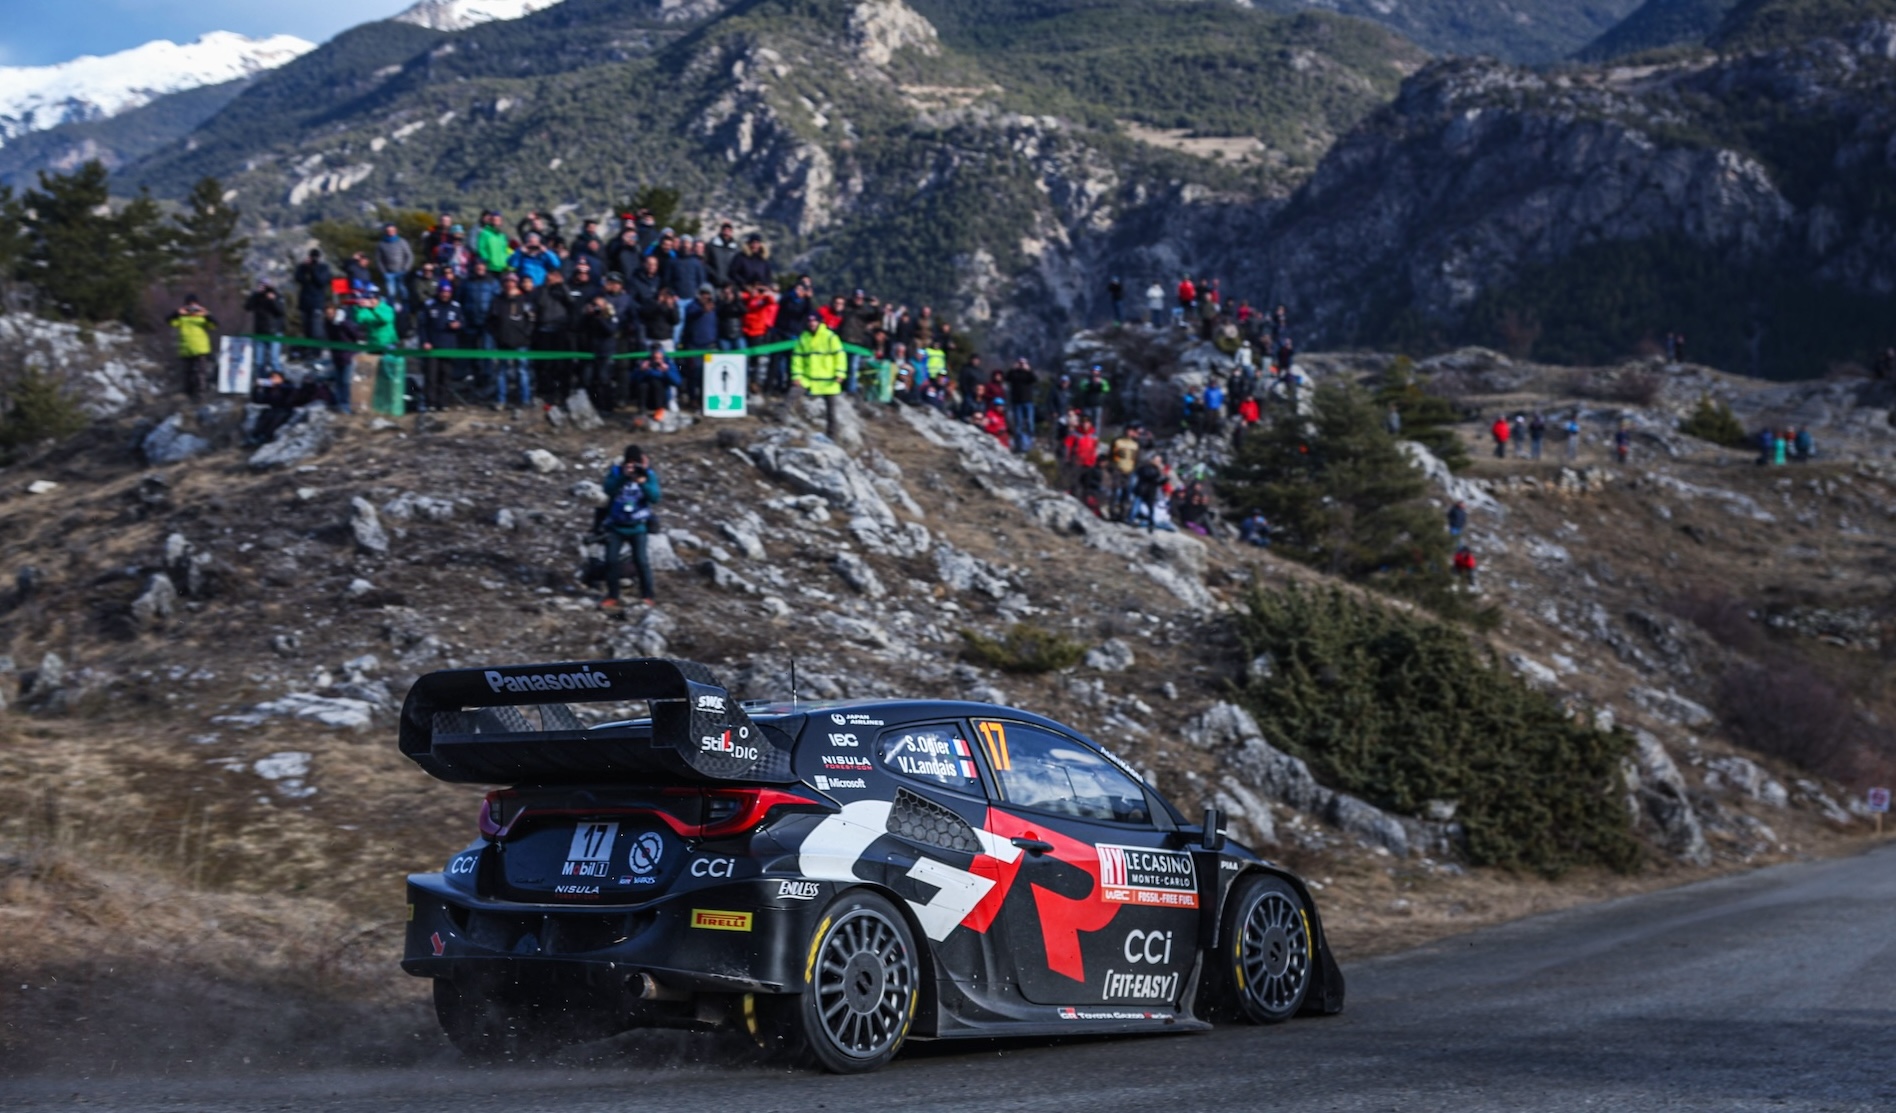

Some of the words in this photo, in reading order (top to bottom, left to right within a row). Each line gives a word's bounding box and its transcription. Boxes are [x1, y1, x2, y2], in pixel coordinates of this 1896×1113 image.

[484, 666, 611, 693] Panasonic
[828, 733, 859, 747] IEC
[904, 734, 950, 757] S.Ogier
[979, 721, 1011, 771] 17
[735, 745, 758, 760] DIC
[821, 755, 871, 766] NISULA
[897, 756, 957, 777] V.Landais
[828, 777, 866, 788] Microsoft
[584, 824, 609, 859] 17
[562, 861, 595, 877] Mobil
[1126, 852, 1140, 871] LE
[1141, 854, 1192, 875] CASINO
[1220, 860, 1239, 870] PIAA
[778, 881, 820, 896] ENDLESS
[1132, 874, 1190, 887] MONTE-CARLO
[554, 885, 600, 894] NISULA
[1105, 890, 1130, 900] WRC
[1178, 894, 1195, 906] FUEL
[696, 912, 747, 928] PIRELLI
